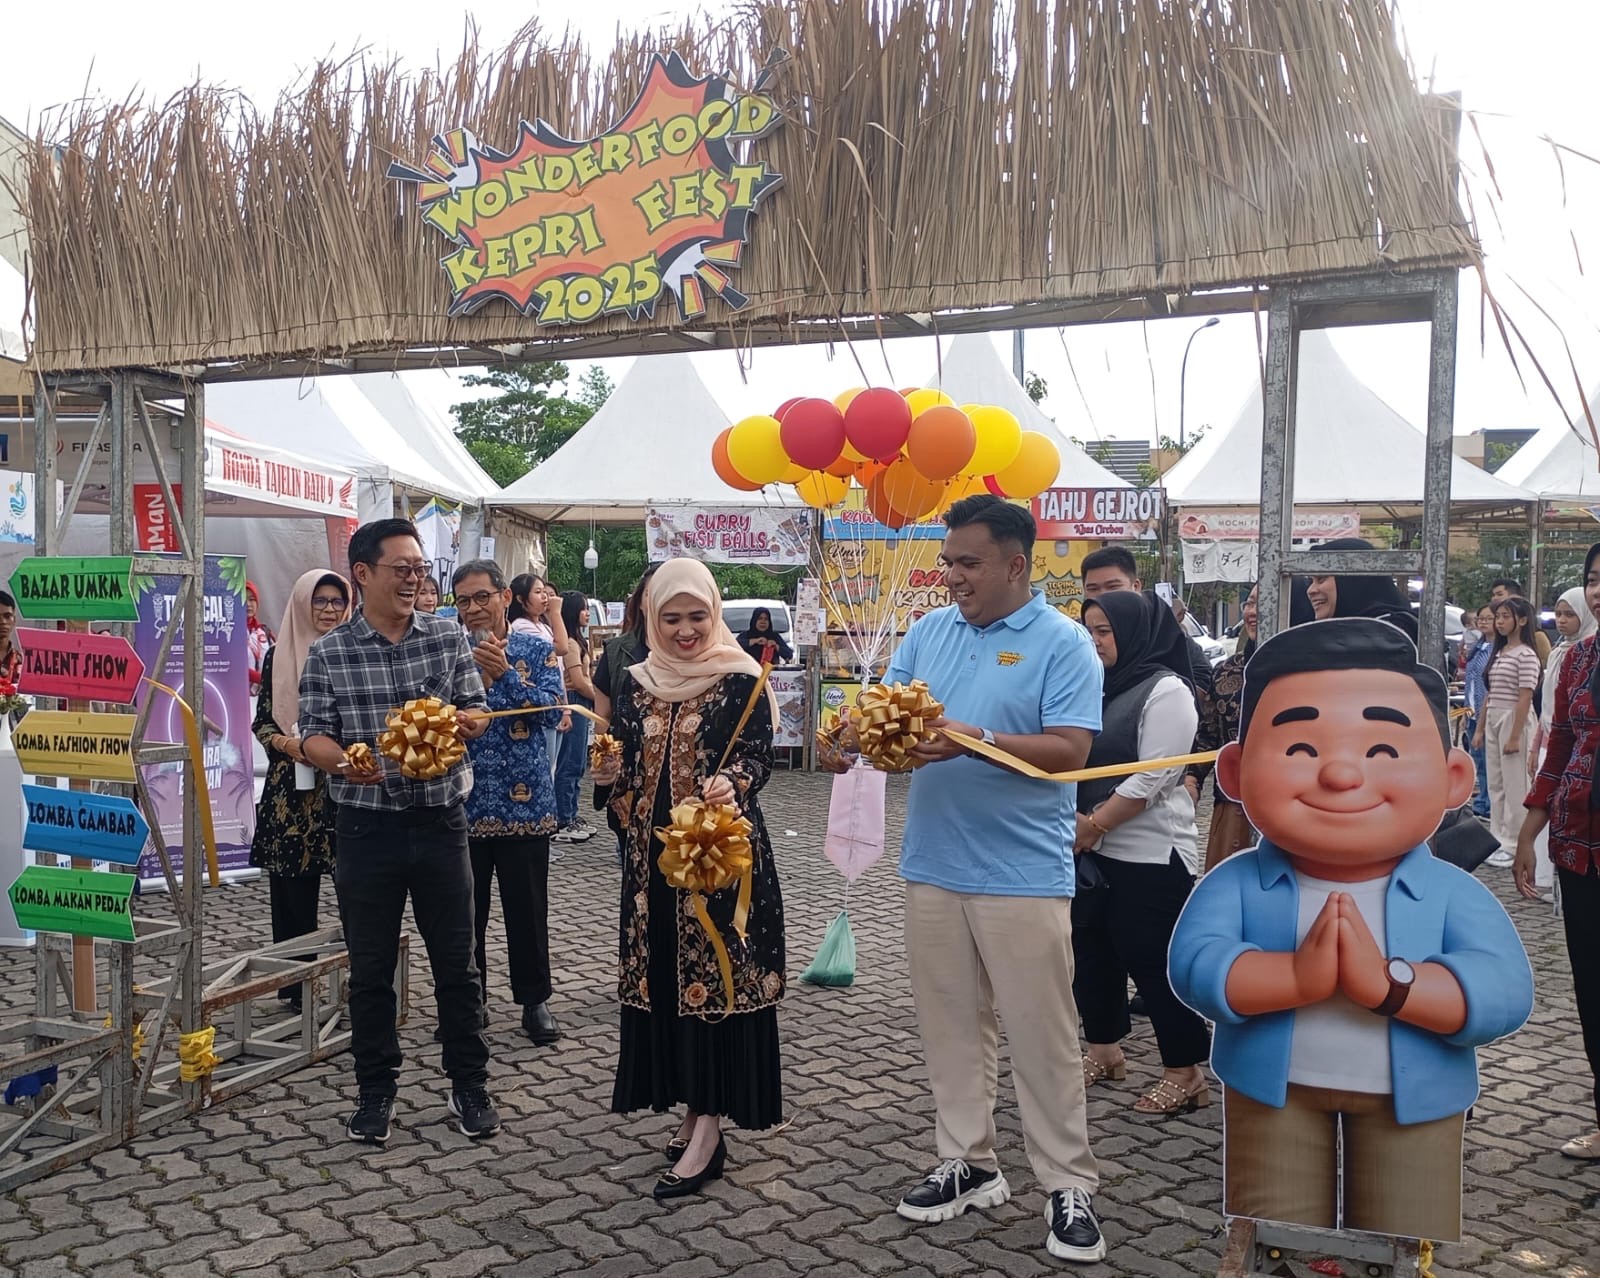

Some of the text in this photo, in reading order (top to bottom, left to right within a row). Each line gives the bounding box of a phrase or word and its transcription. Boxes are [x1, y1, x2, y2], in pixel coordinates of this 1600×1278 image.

[425, 95, 773, 238] WONDERFOOD
[444, 162, 765, 293] KEPRI FEST
[536, 252, 663, 323] 2025
[222, 448, 262, 489] HONDA
[265, 460, 301, 497] TAJELIN
[303, 470, 326, 504] BATU
[327, 478, 334, 504] 9
[1038, 490, 1161, 521] TAHU GEJROT
[695, 514, 752, 532] CURRY
[1219, 519, 1247, 527] MOCHI
[684, 531, 768, 550] FISH BALLS
[20, 574, 123, 600] BAZAR UMKM
[25, 648, 129, 681] TALENT SHOW
[16, 733, 130, 756] LOMBA FASHION SHOW
[29, 802, 75, 829] LOMBA
[78, 808, 136, 837] GAMBAR
[15, 886, 128, 914] LOMBA MAKAN PEDAS
